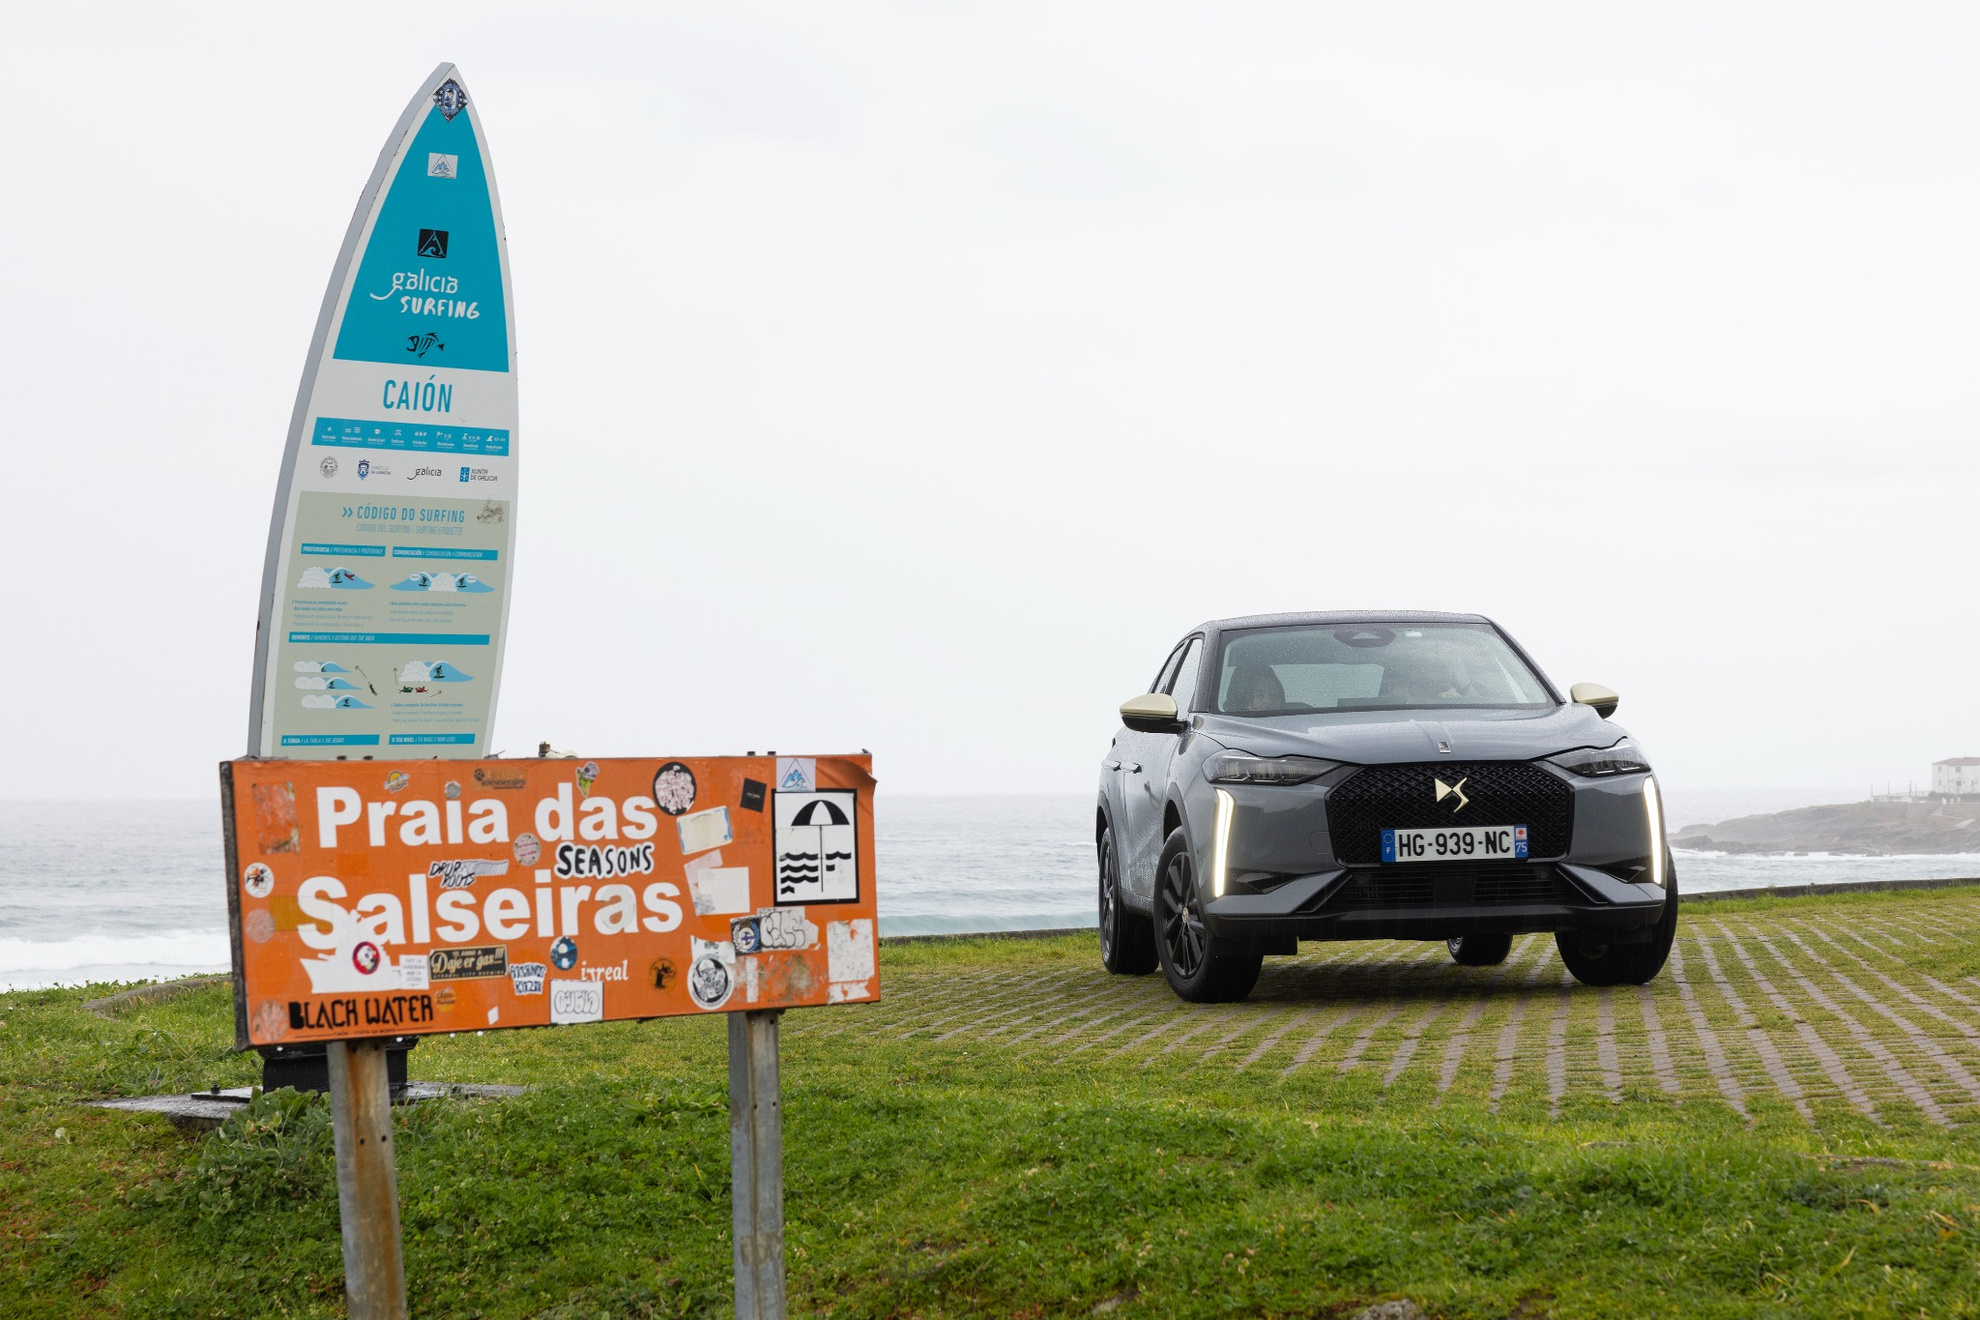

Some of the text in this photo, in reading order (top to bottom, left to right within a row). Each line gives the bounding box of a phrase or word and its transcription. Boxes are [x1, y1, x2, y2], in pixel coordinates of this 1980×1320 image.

[370, 268, 458, 300] galicia
[400, 296, 480, 319] SURFING
[383, 375, 452, 413] CAIÓN
[407, 467, 441, 480] galicia
[357, 503, 465, 523] CÓDIGO DO SURFING
[316, 786, 511, 848] Praia
[535, 782, 658, 842] das
[1398, 830, 1511, 857] HG-939-NC
[1516, 841, 1528, 853] 75
[557, 844, 653, 876] SEASONS
[297, 868, 683, 951] Salseiras
[431, 951, 464, 974] Daje
[365, 994, 434, 1026] WATER
